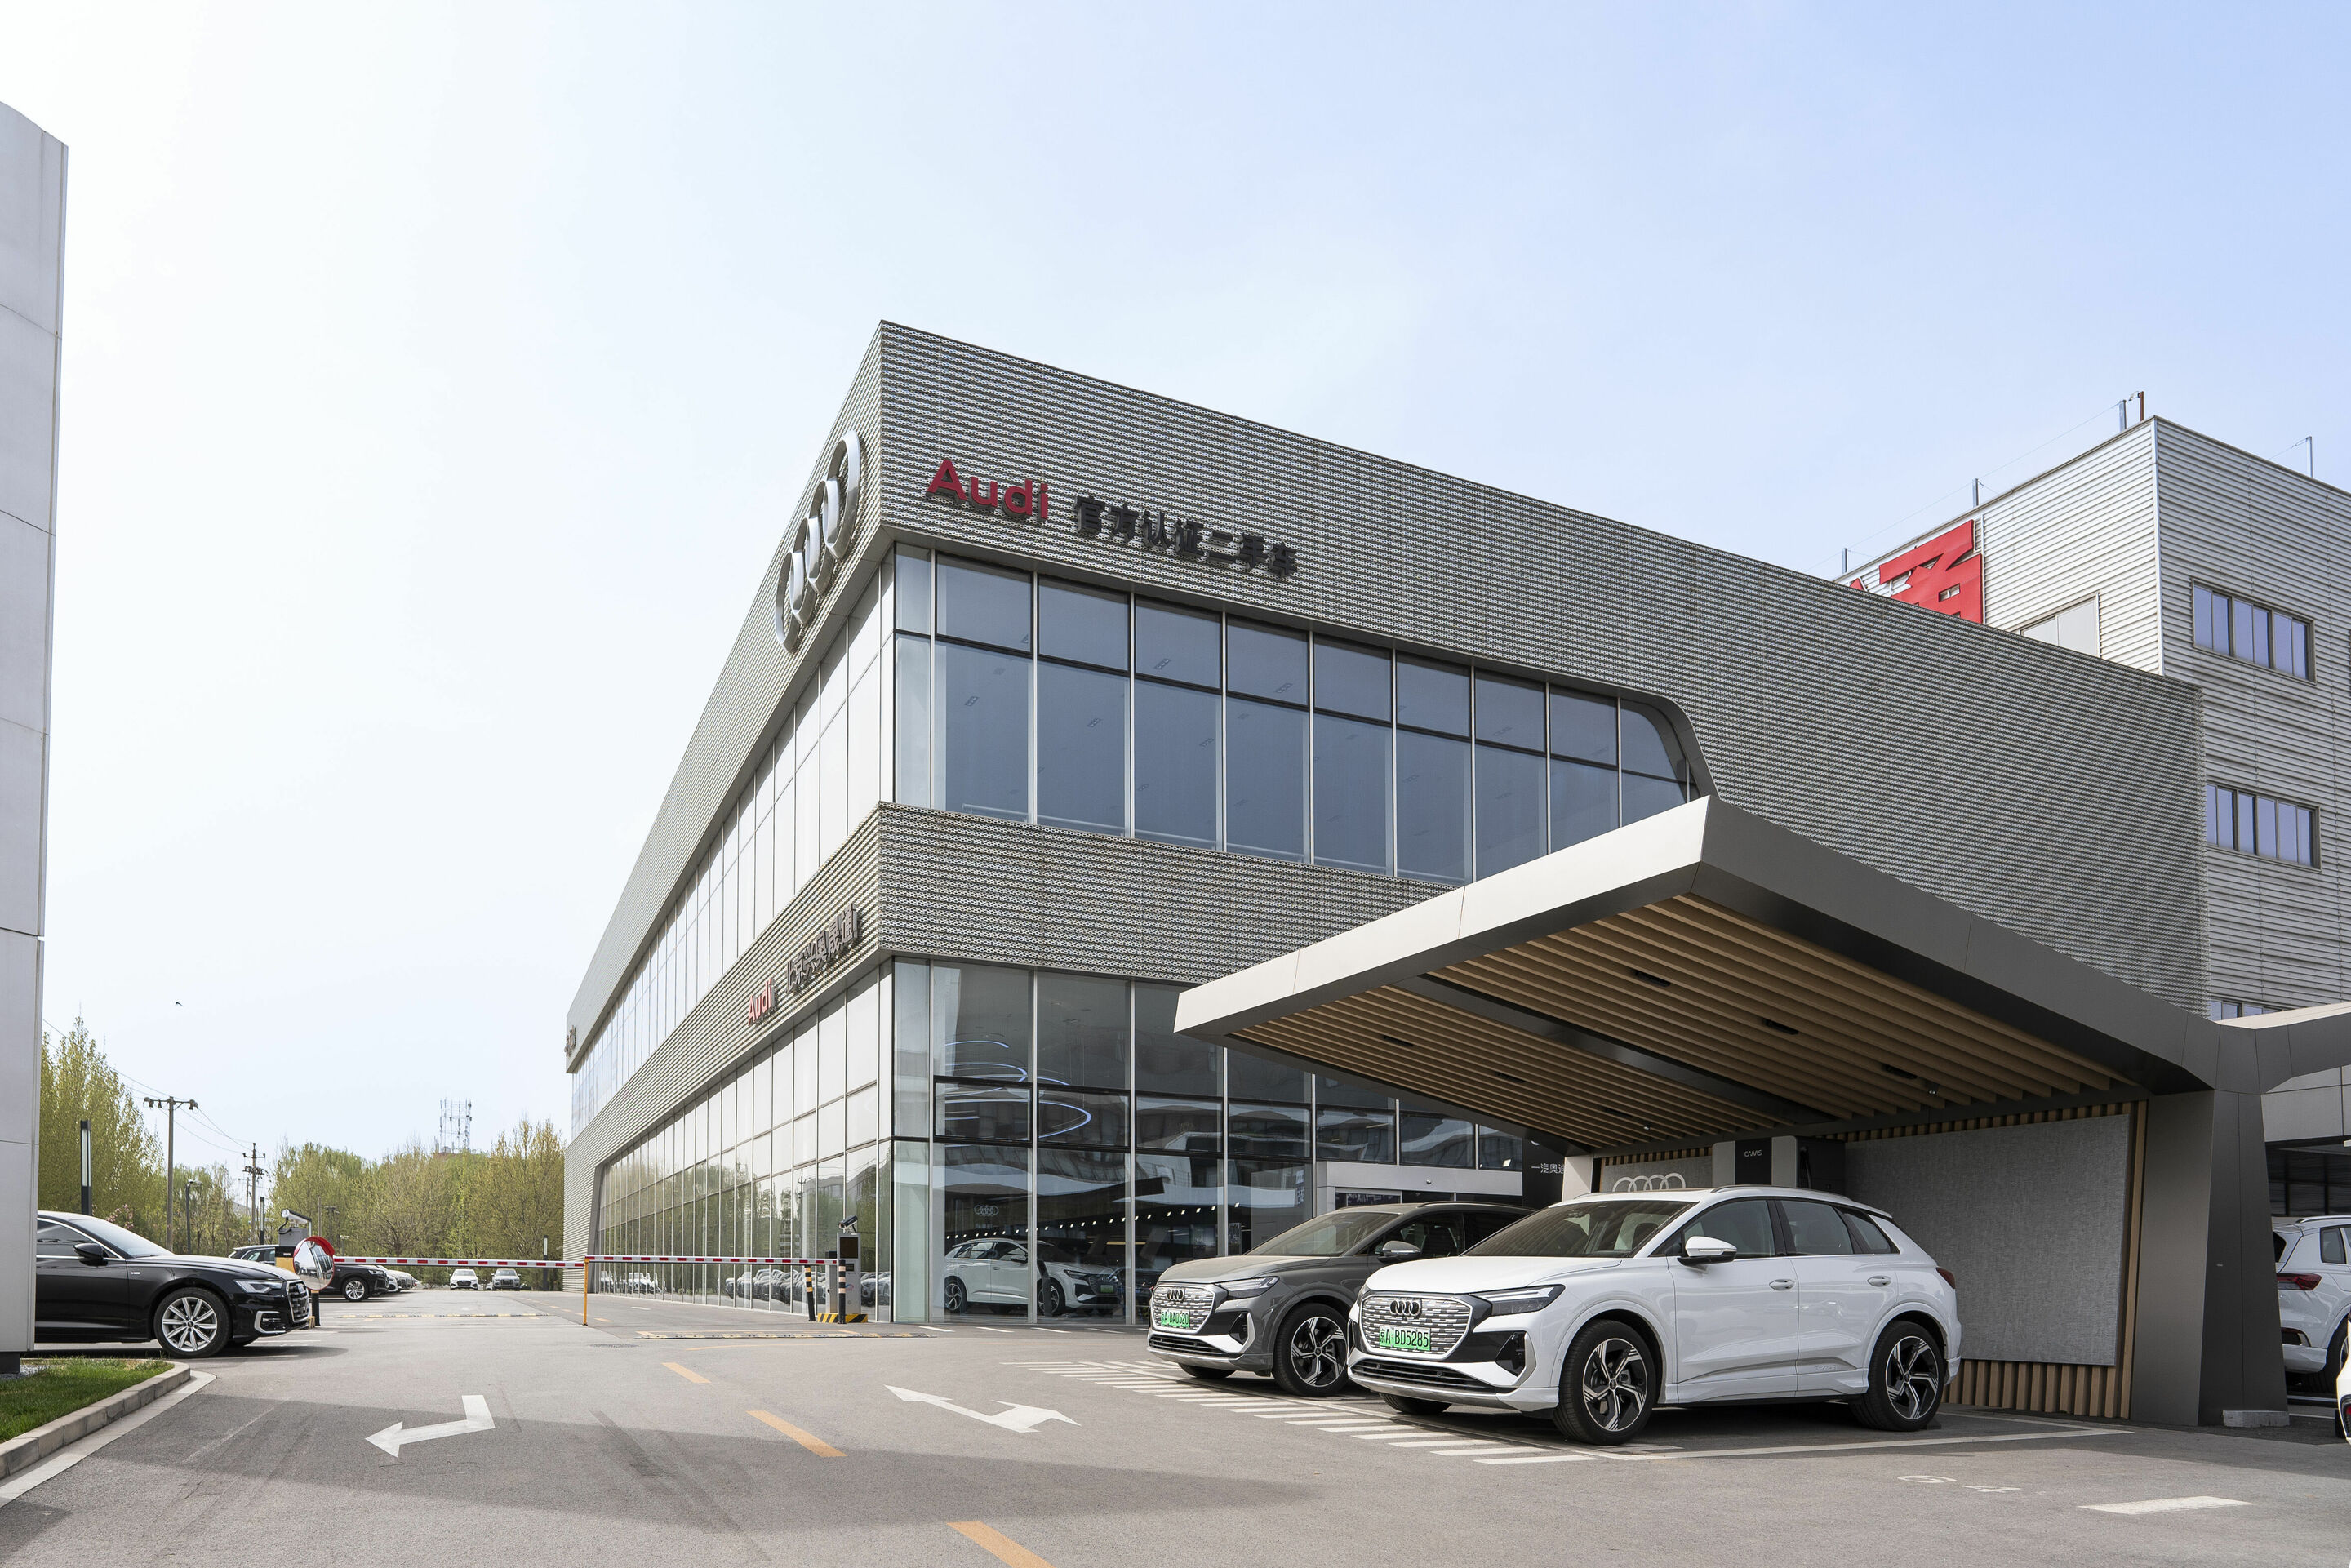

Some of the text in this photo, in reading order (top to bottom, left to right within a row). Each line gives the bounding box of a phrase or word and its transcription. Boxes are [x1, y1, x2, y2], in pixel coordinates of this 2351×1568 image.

[926, 459, 1298, 578] Audi 官方认证二手车
[747, 978, 774, 1027] Audi
